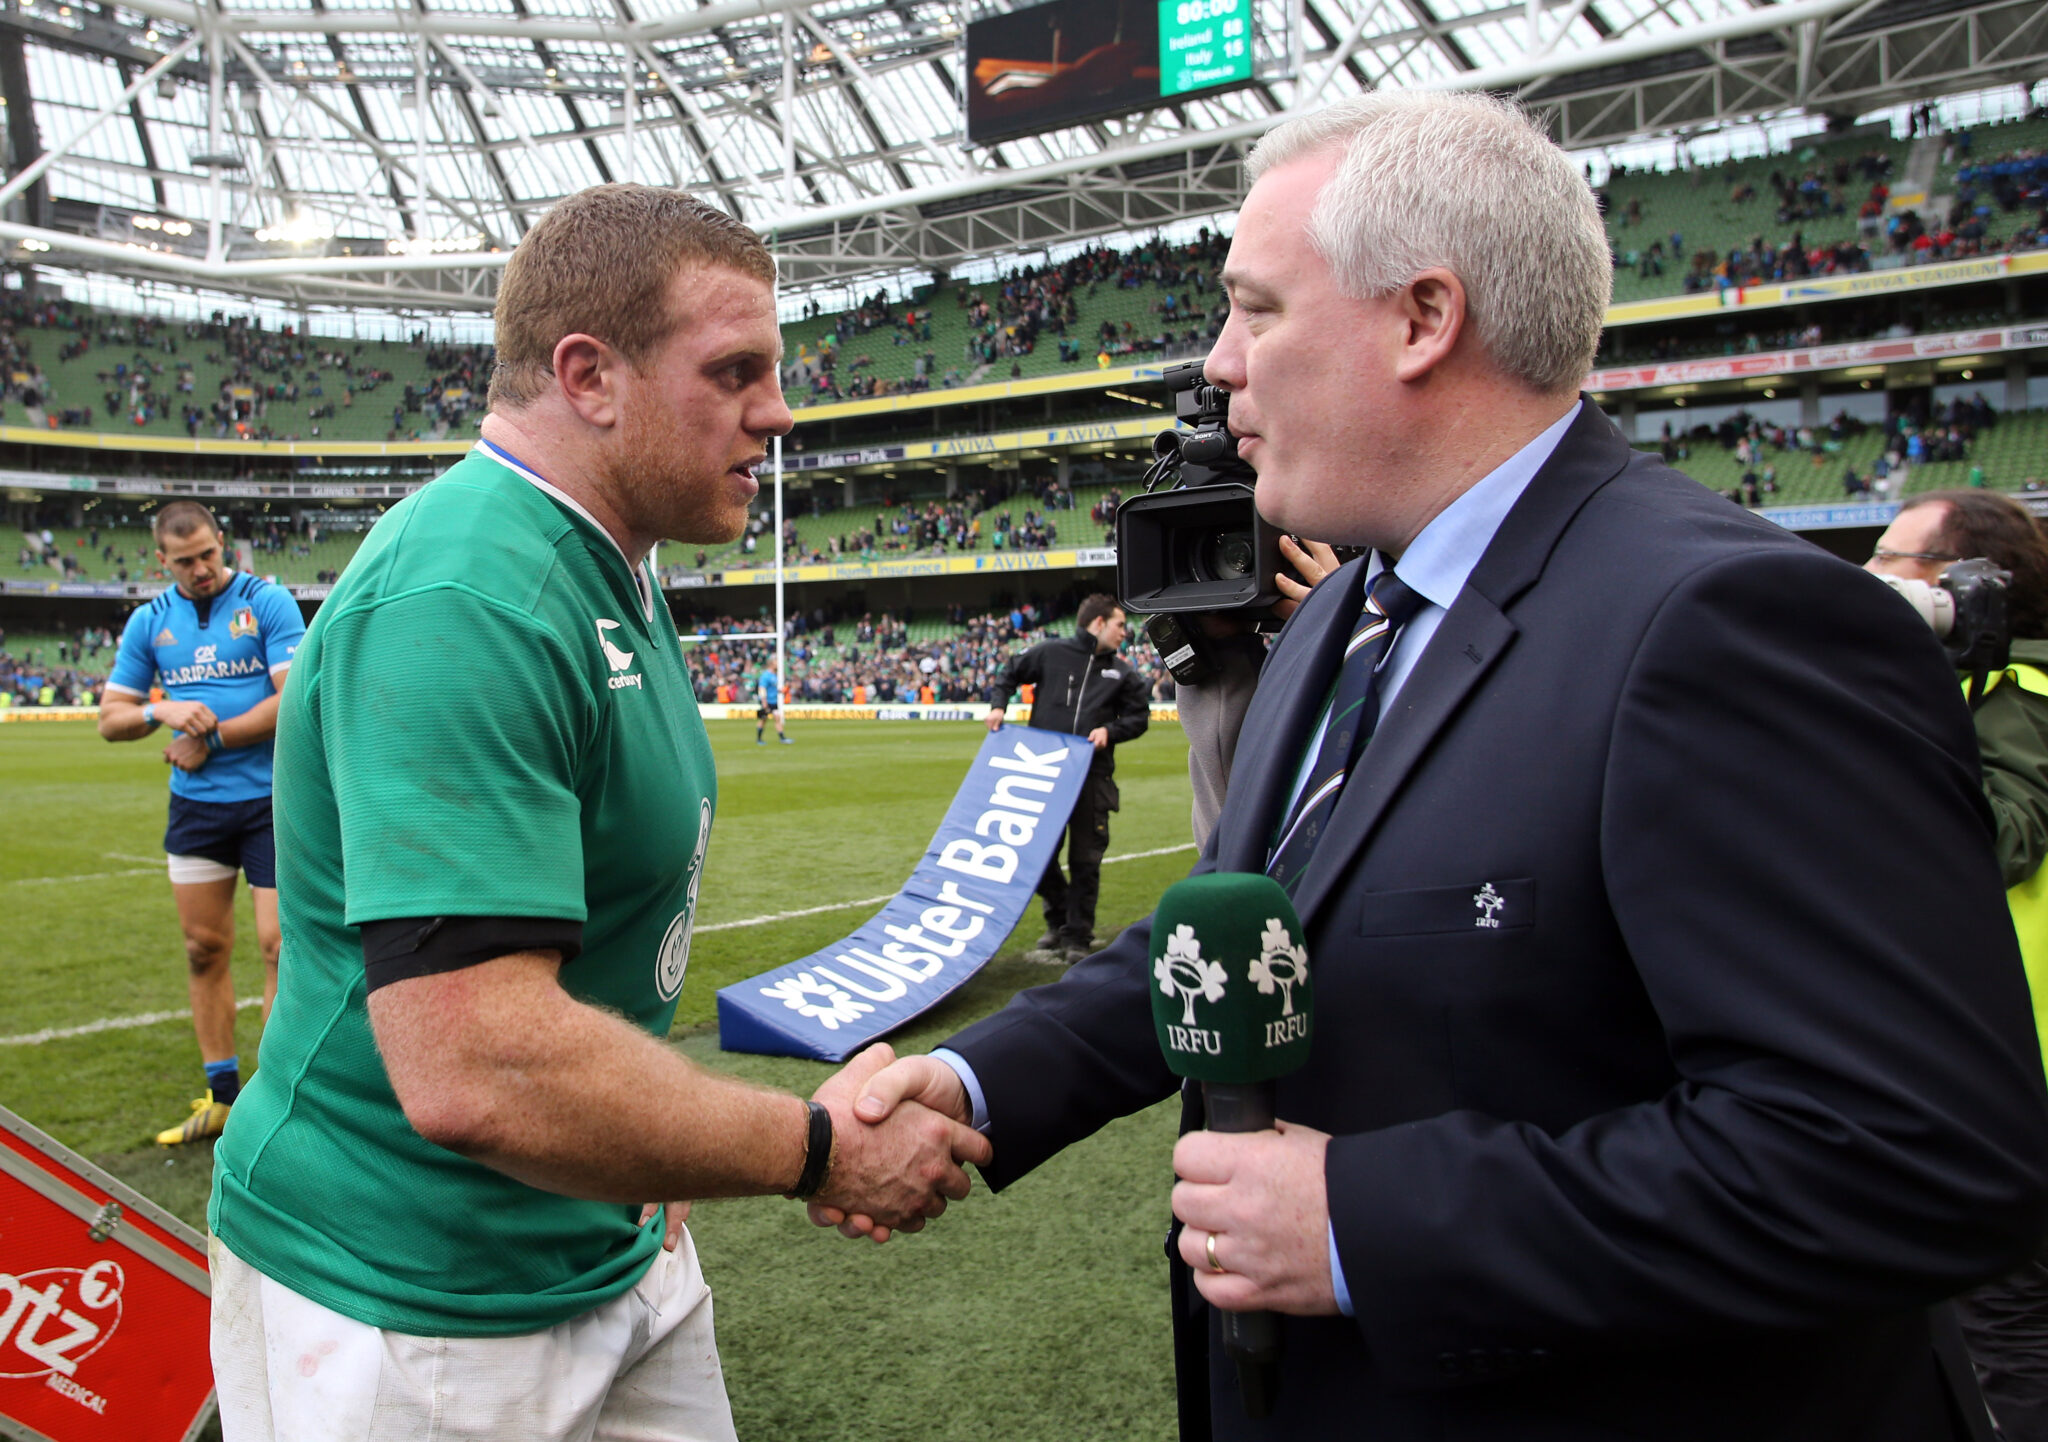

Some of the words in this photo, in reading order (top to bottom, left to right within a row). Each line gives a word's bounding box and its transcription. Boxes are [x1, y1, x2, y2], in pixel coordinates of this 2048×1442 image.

[1169, 28, 1213, 51] Ireland
[1185, 49, 1213, 66] Italy
[1848, 277, 1904, 293] AVIVA
[1911, 262, 2000, 285] STADIUM
[1064, 425, 1118, 443] AVIVA
[1194, 432, 1212, 440] SONY
[947, 437, 996, 455] AVIVA
[860, 449, 887, 463] Park
[836, 565, 872, 578] Home
[877, 560, 942, 577] Insurance
[992, 553, 1048, 570] AVIVA
[163, 656, 264, 686] CARIPARMA
[813, 881, 995, 1002] Ulster
[937, 741, 1069, 884] Bank
[1475, 917, 1500, 928] IRFU
[1264, 1012, 1307, 1048] IRFU
[1166, 1024, 1221, 1055] IRFU
[45, 1372, 108, 1415] MEDICAL
